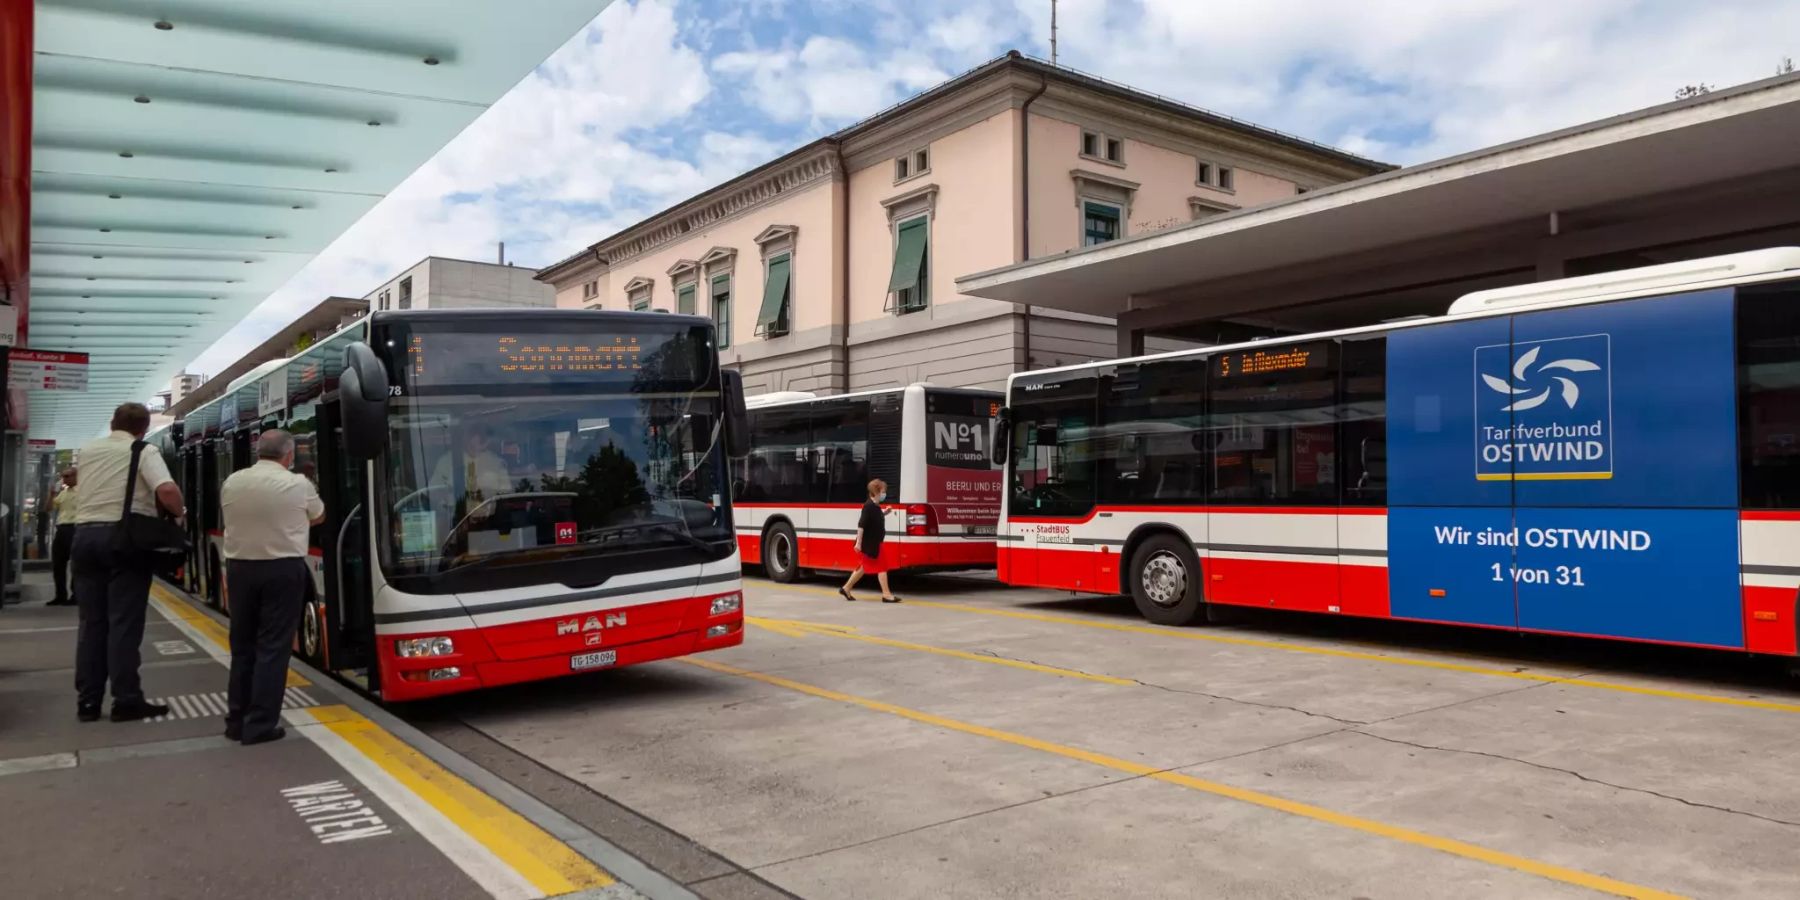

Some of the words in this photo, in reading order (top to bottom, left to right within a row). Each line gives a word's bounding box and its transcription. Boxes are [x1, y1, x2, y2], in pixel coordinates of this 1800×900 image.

[389, 385, 402, 396] 78
[1025, 383, 1044, 391] MAN
[1483, 420, 1602, 441] Tarifverbund
[1482, 440, 1604, 463] OSTWIND
[946, 481, 972, 491] BEERLI
[974, 482, 991, 492] UND
[1036, 525, 1070, 534] StadtBUS
[1037, 534, 1070, 543] Frauenfeld
[1433, 525, 1471, 546] Wir
[1476, 527, 1519, 547] sind
[1524, 529, 1651, 552] OSTWIND
[1491, 562, 1504, 582] 1
[1510, 567, 1550, 584] von
[1555, 565, 1585, 587] 31
[557, 611, 628, 636] MAN
[573, 656, 583, 667] TG
[280, 780, 392, 844] WARTEN
